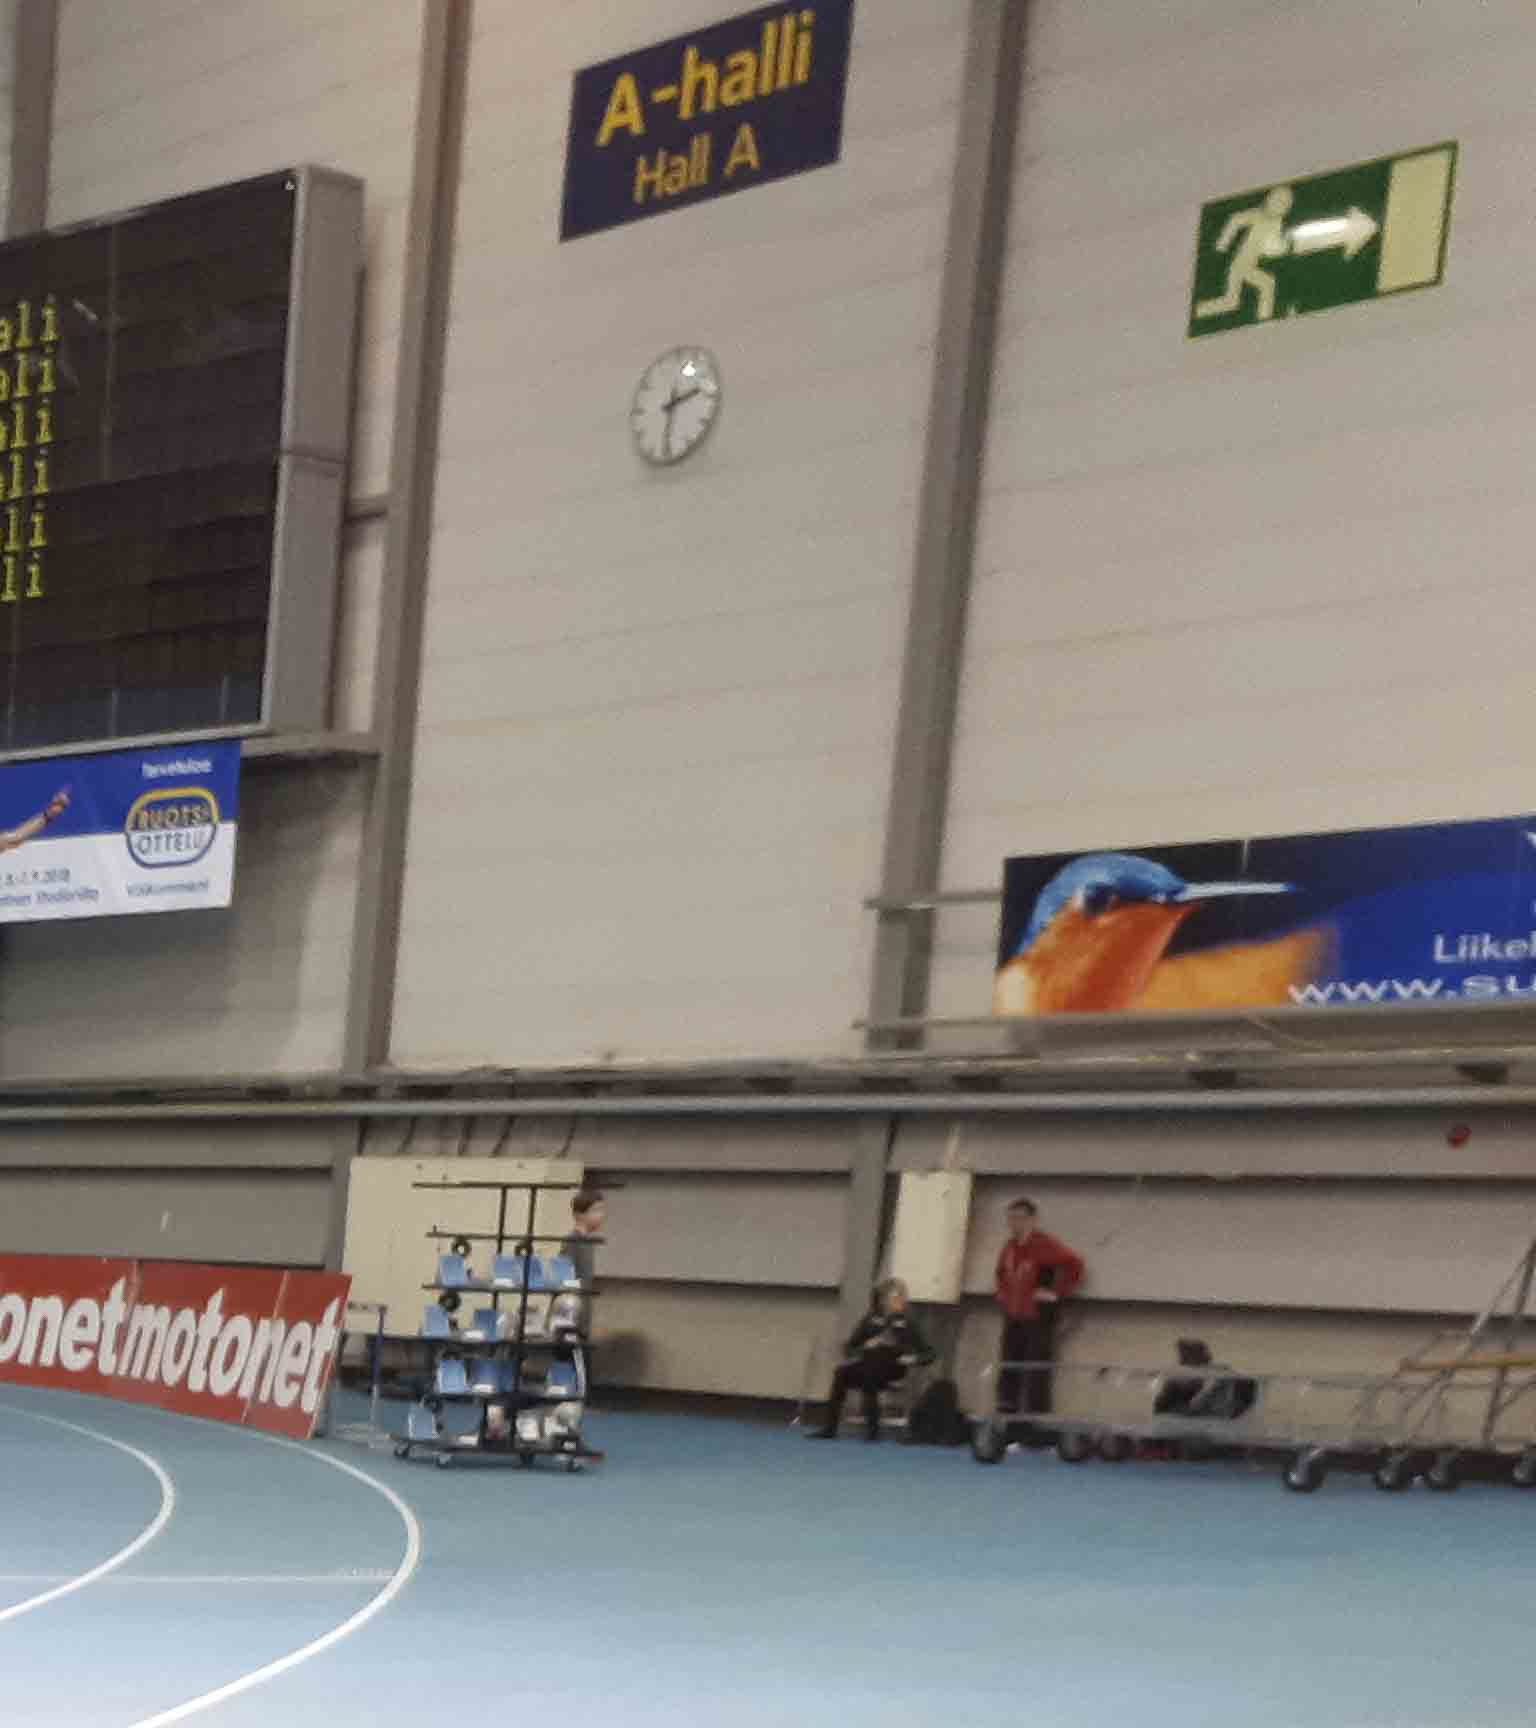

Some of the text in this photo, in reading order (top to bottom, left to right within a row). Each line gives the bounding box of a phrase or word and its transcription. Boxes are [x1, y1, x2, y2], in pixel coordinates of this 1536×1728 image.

[595, 10, 816, 147] A-halli
[633, 122, 762, 205] Hall A
[118, 1286, 342, 1415] motonet
